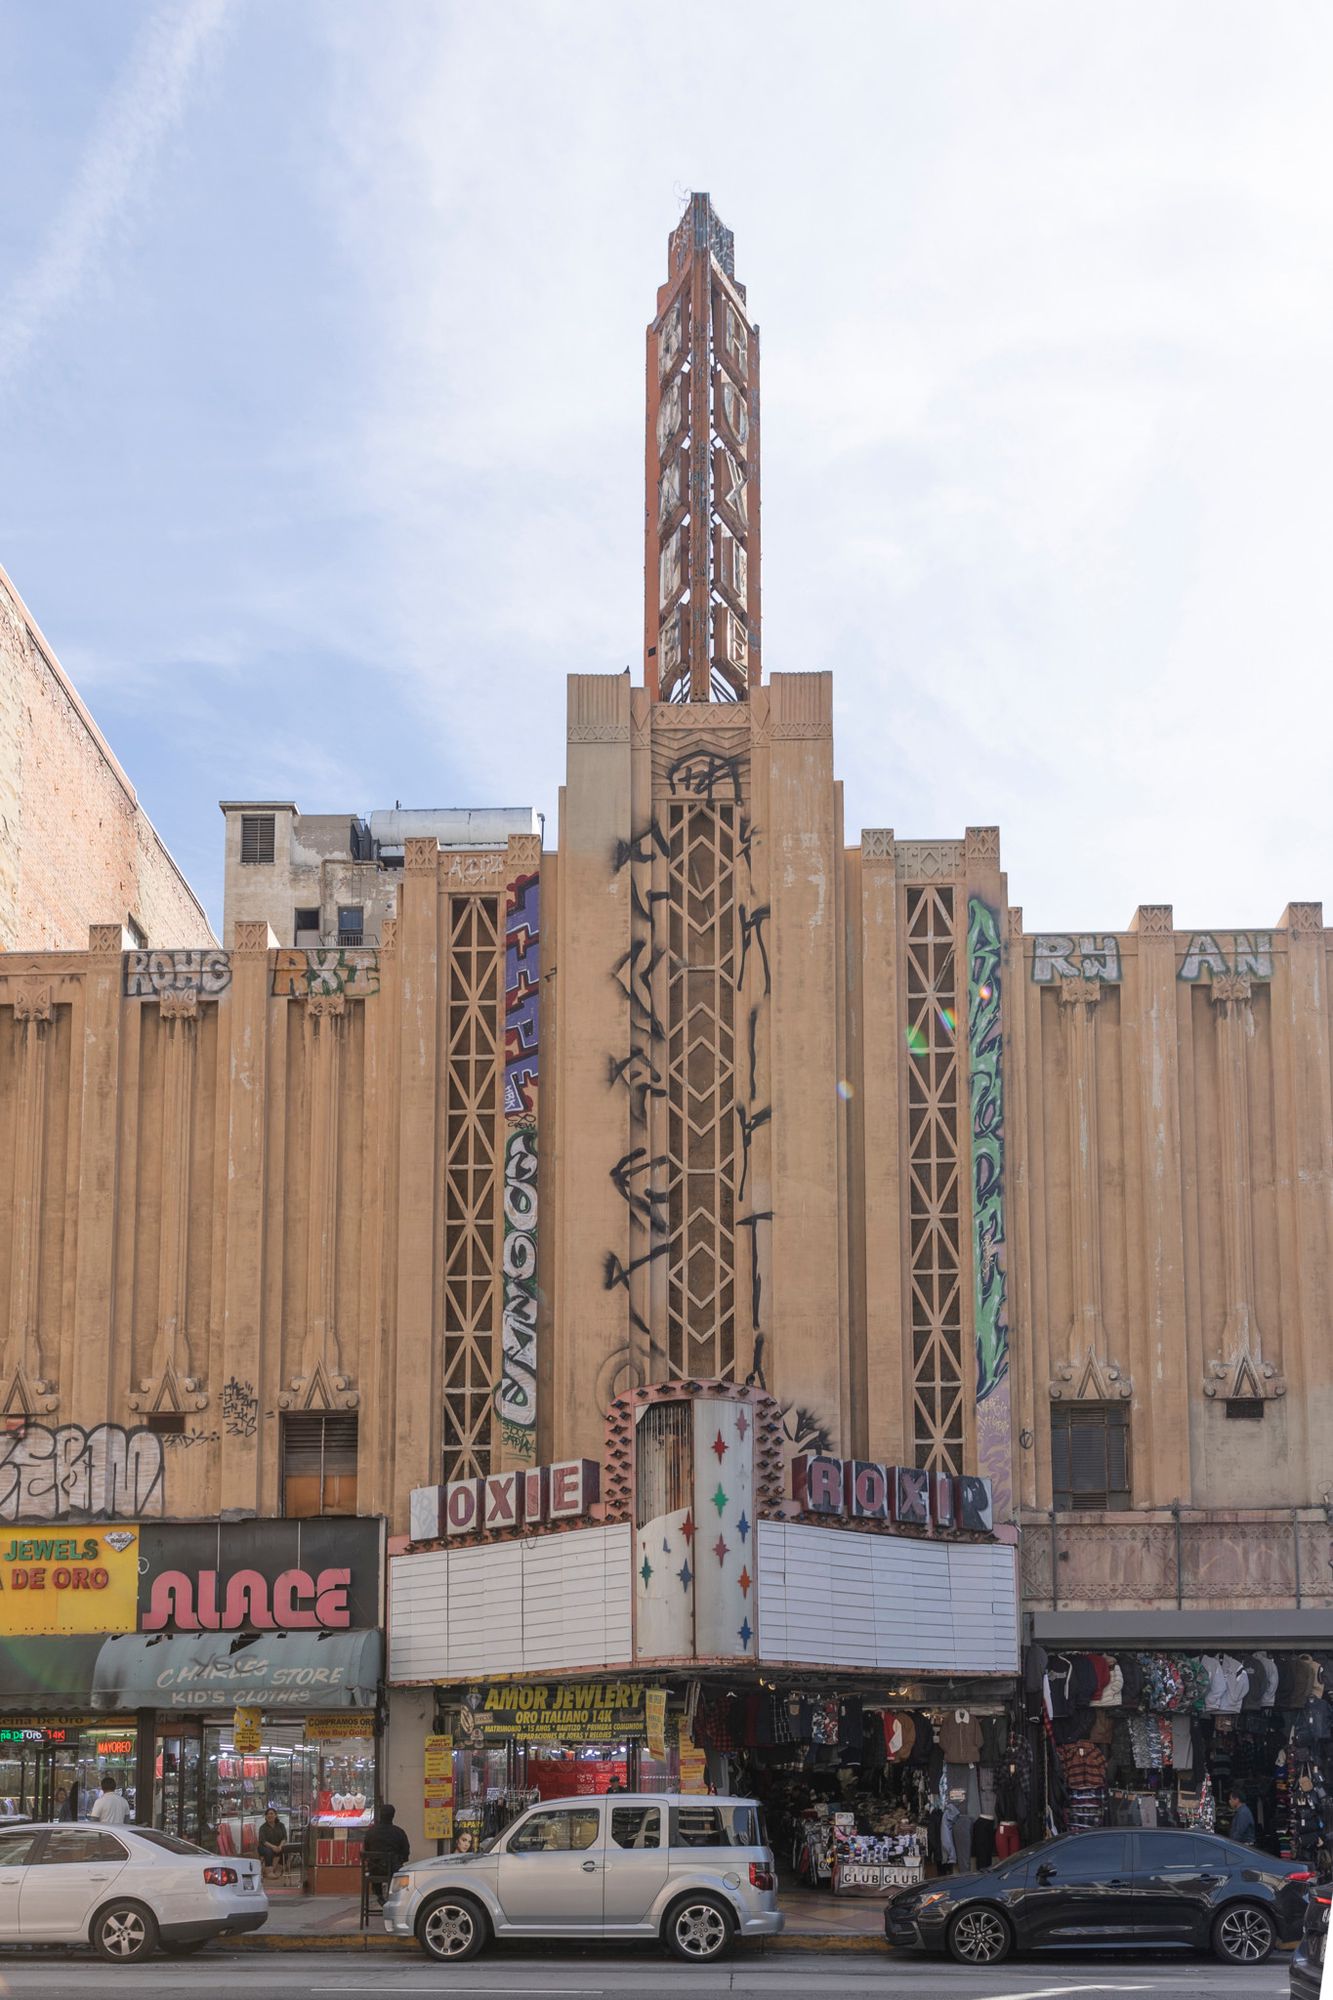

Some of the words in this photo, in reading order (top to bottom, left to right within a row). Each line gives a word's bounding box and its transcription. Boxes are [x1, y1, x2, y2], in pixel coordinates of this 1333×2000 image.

[4, 1538, 98, 1560] JEWELS
[11, 1567, 46, 1590] DE
[52, 1567, 109, 1589] ORO
[271, 1667, 344, 1685] STORE
[171, 1691, 225, 1704] KID'S
[232, 1690, 311, 1704] CLOTHES
[484, 1685, 548, 1710] AMOR
[552, 1684, 645, 1709] JEWLERY
[308, 1718, 358, 1727] COMPRAMOS
[515, 1711, 538, 1724] ORO
[540, 1711, 589, 1724] ITALIANO
[592, 1710, 613, 1722] 14K
[332, 1729, 347, 1737] Buy
[97, 1741, 132, 1754] MAYOREO
[844, 1873, 878, 1884] CLUB
[884, 1874, 919, 1884] CLUB
